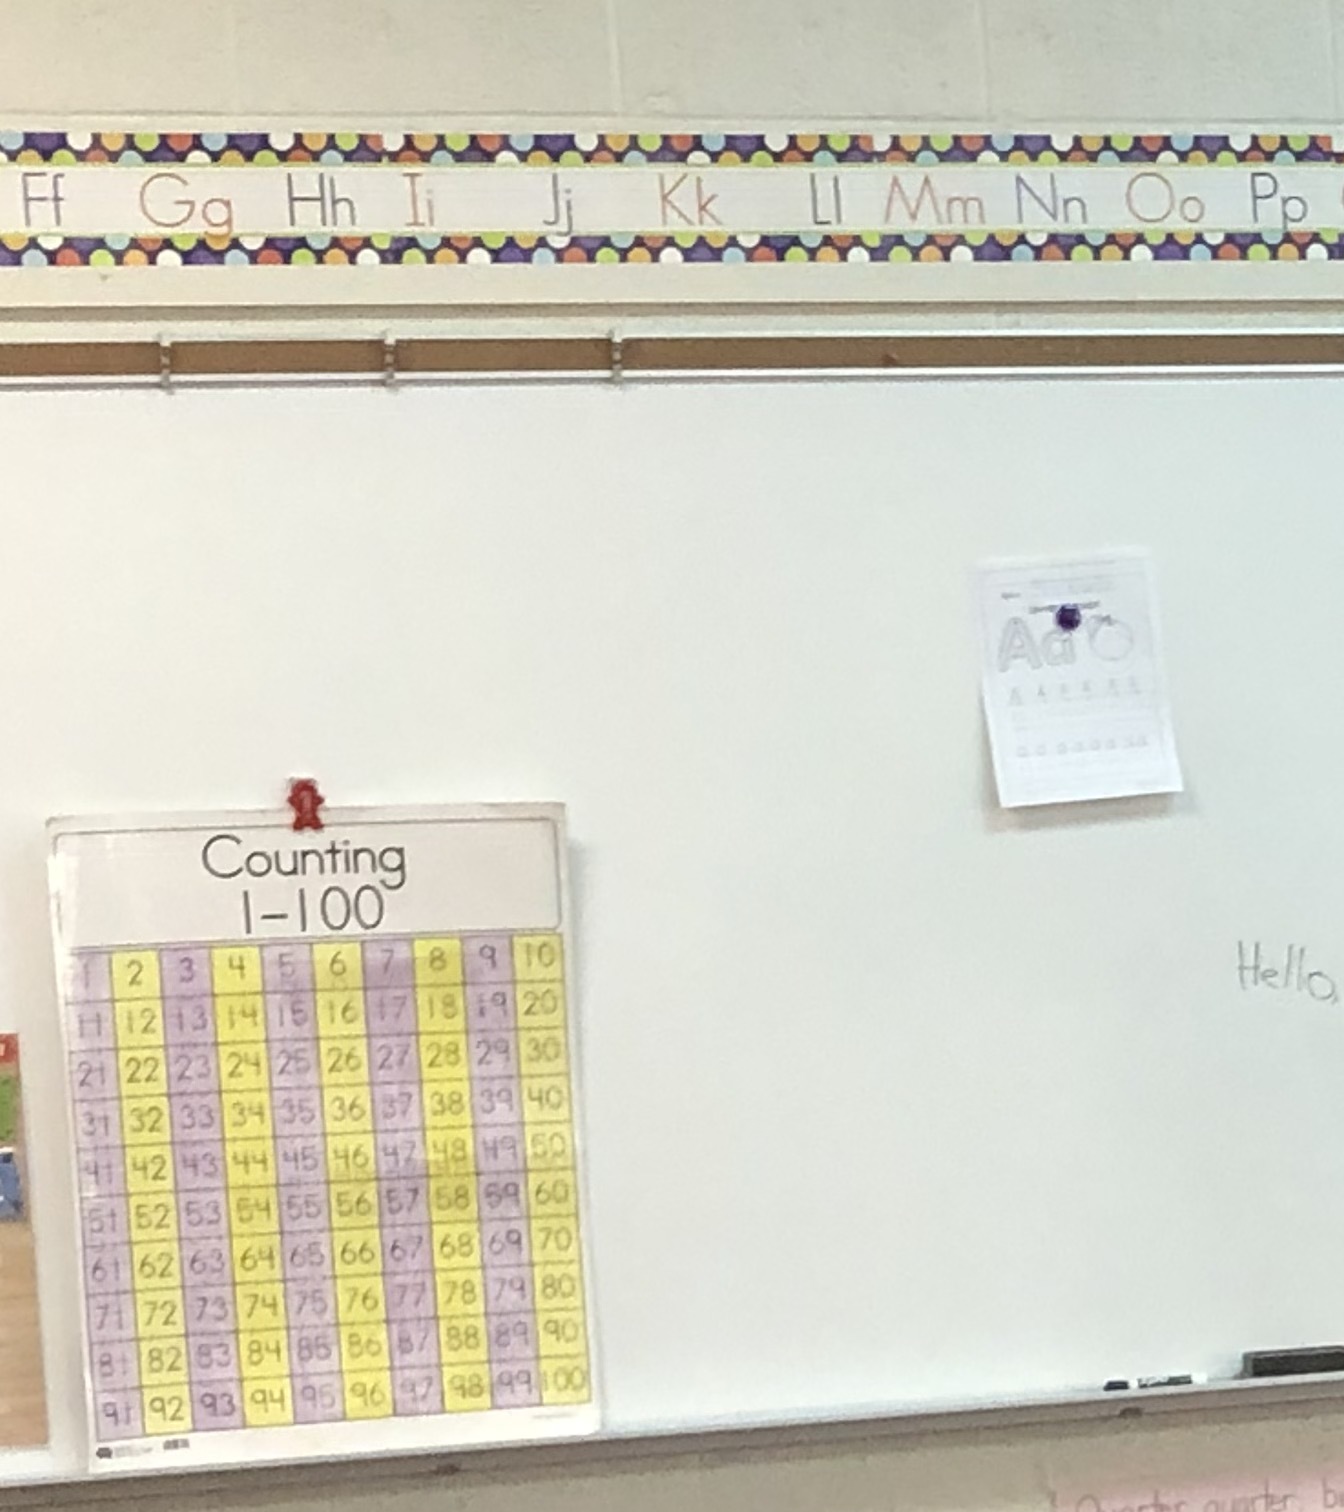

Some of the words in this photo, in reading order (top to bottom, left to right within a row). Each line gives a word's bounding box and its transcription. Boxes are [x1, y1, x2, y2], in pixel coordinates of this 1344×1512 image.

[21, 172, 65, 228] Ff
[138, 172, 233, 236] Gg
[287, 172, 356, 228] Hh
[403, 172, 434, 228] Ii
[543, 173, 575, 236] Jj
[656, 173, 723, 228] Kk
[811, 173, 842, 226] Ll
[884, 174, 985, 225] Mm
[1014, 174, 1088, 225] Nn
[1125, 172, 1204, 224] Oo
[1250, 173, 1307, 233] Pp
[201, 834, 406, 890] Counting
[242, 885, 385, 933] 1-100
[127, 960, 144, 984] 2
[228, 956, 245, 980] 4
[329, 952, 346, 975] 6
[429, 948, 446, 971] 8
[122, 1008, 157, 1033] 12
[223, 1003, 260, 1029] 14
[324, 999, 360, 1024] 16
[424, 995, 458, 1019] 18
[125, 1057, 160, 1083] 22
[227, 1052, 263, 1078] 24
[327, 1047, 363, 1073] 26
[427, 1042, 461, 1068] 28
[128, 1105, 164, 1132] 32
[230, 1100, 266, 1127] 34
[331, 1095, 366, 1121] 36
[429, 1090, 464, 1116] 38
[131, 1155, 167, 1181] 42
[233, 1149, 269, 1175] 44
[334, 1144, 369, 1170] 46
[432, 1138, 467, 1164] 48
[135, 1203, 170, 1229] 52
[236, 1197, 272, 1223] 54
[337, 1191, 372, 1217] 56
[435, 1185, 470, 1211] 58
[138, 1253, 173, 1278] 62
[239, 1246, 275, 1272] 64
[340, 1240, 375, 1265] 66
[438, 1234, 473, 1259] 68
[141, 1301, 177, 1326] 72
[242, 1294, 278, 1319] 74
[343, 1287, 378, 1312] 76
[441, 1281, 476, 1306] 78
[144, 1348, 180, 1373] 82
[246, 1341, 281, 1366] 84
[346, 1334, 381, 1359] 86
[444, 1327, 479, 1352] 88
[148, 1396, 183, 1422] 92
[249, 1388, 284, 1414] 94
[349, 1380, 384, 1406] 96
[447, 1373, 482, 1399] 98
